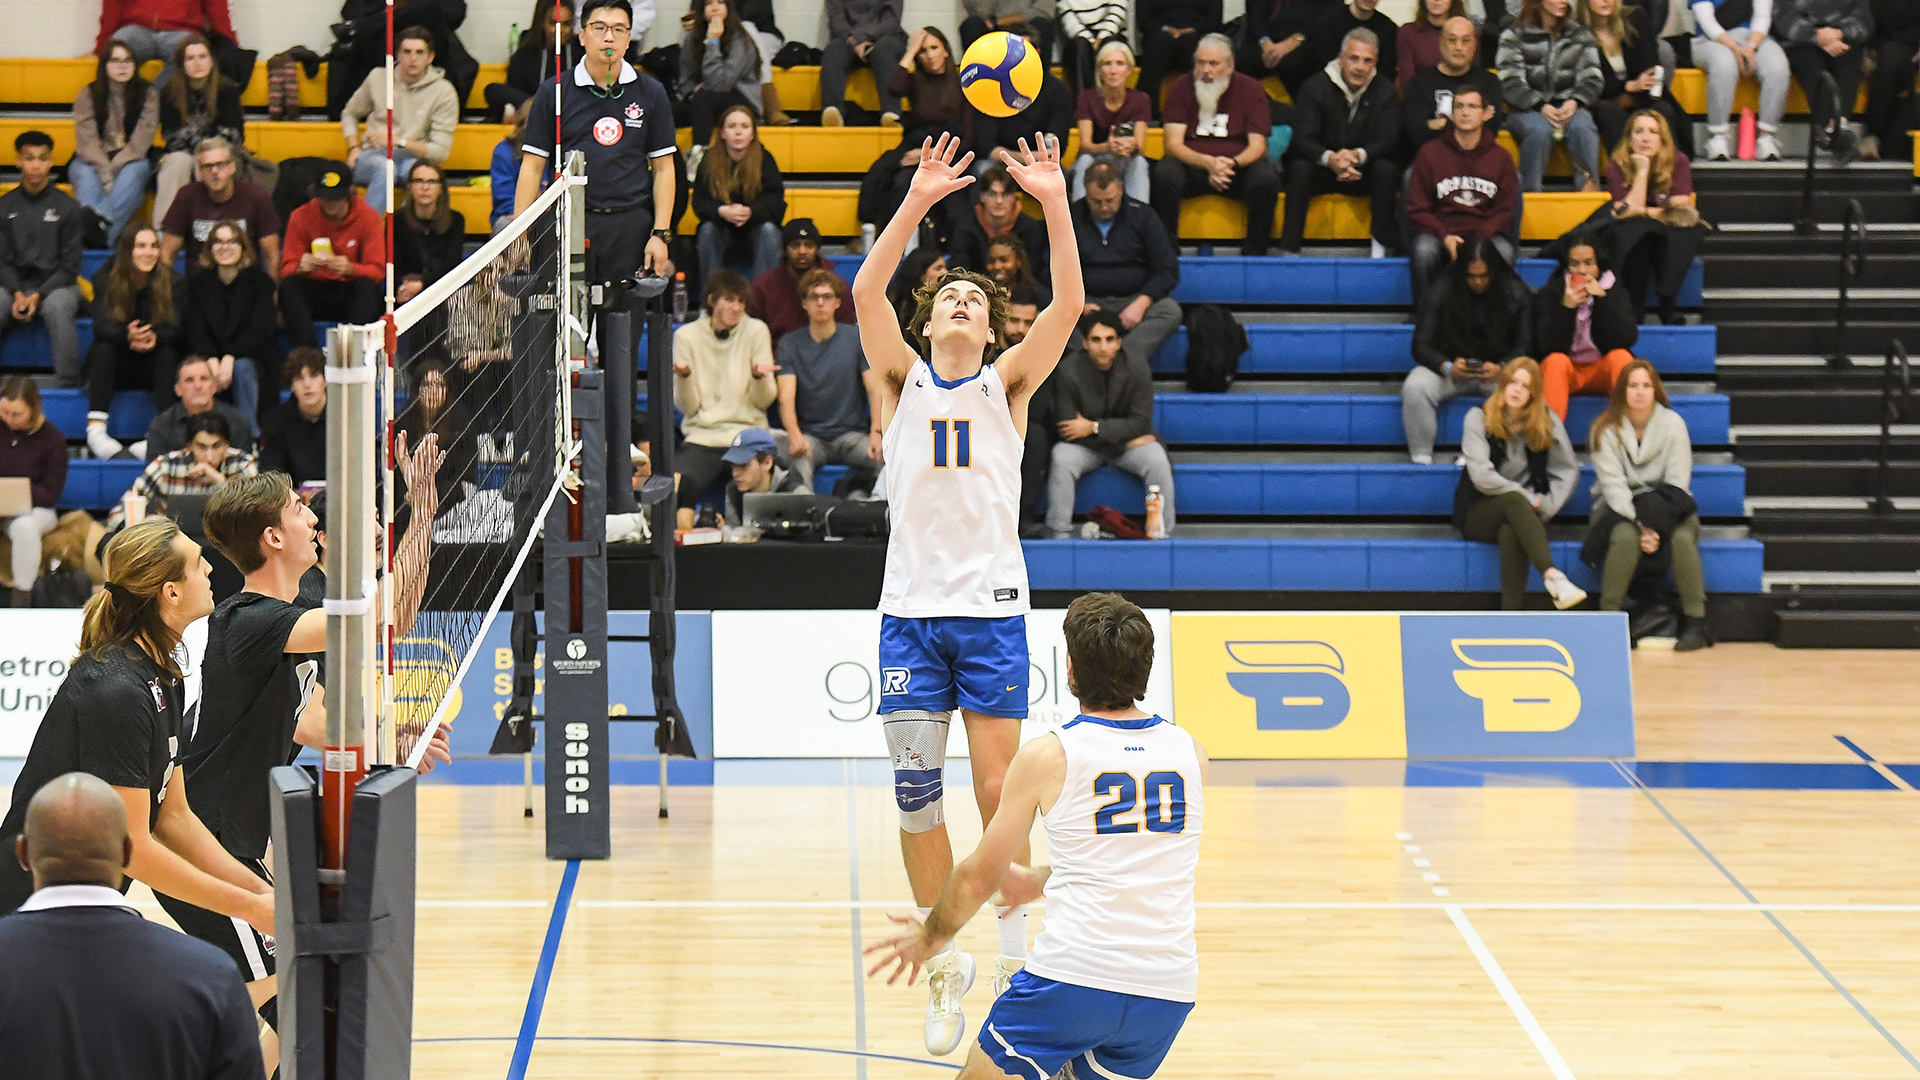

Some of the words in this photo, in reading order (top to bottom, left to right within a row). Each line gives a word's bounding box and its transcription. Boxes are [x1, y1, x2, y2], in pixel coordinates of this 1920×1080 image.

[930, 418, 972, 469] 11
[0, 656, 66, 676] etro
[882, 667, 911, 696] R
[0, 688, 52, 711] Uni
[1092, 769, 1188, 835] 20
